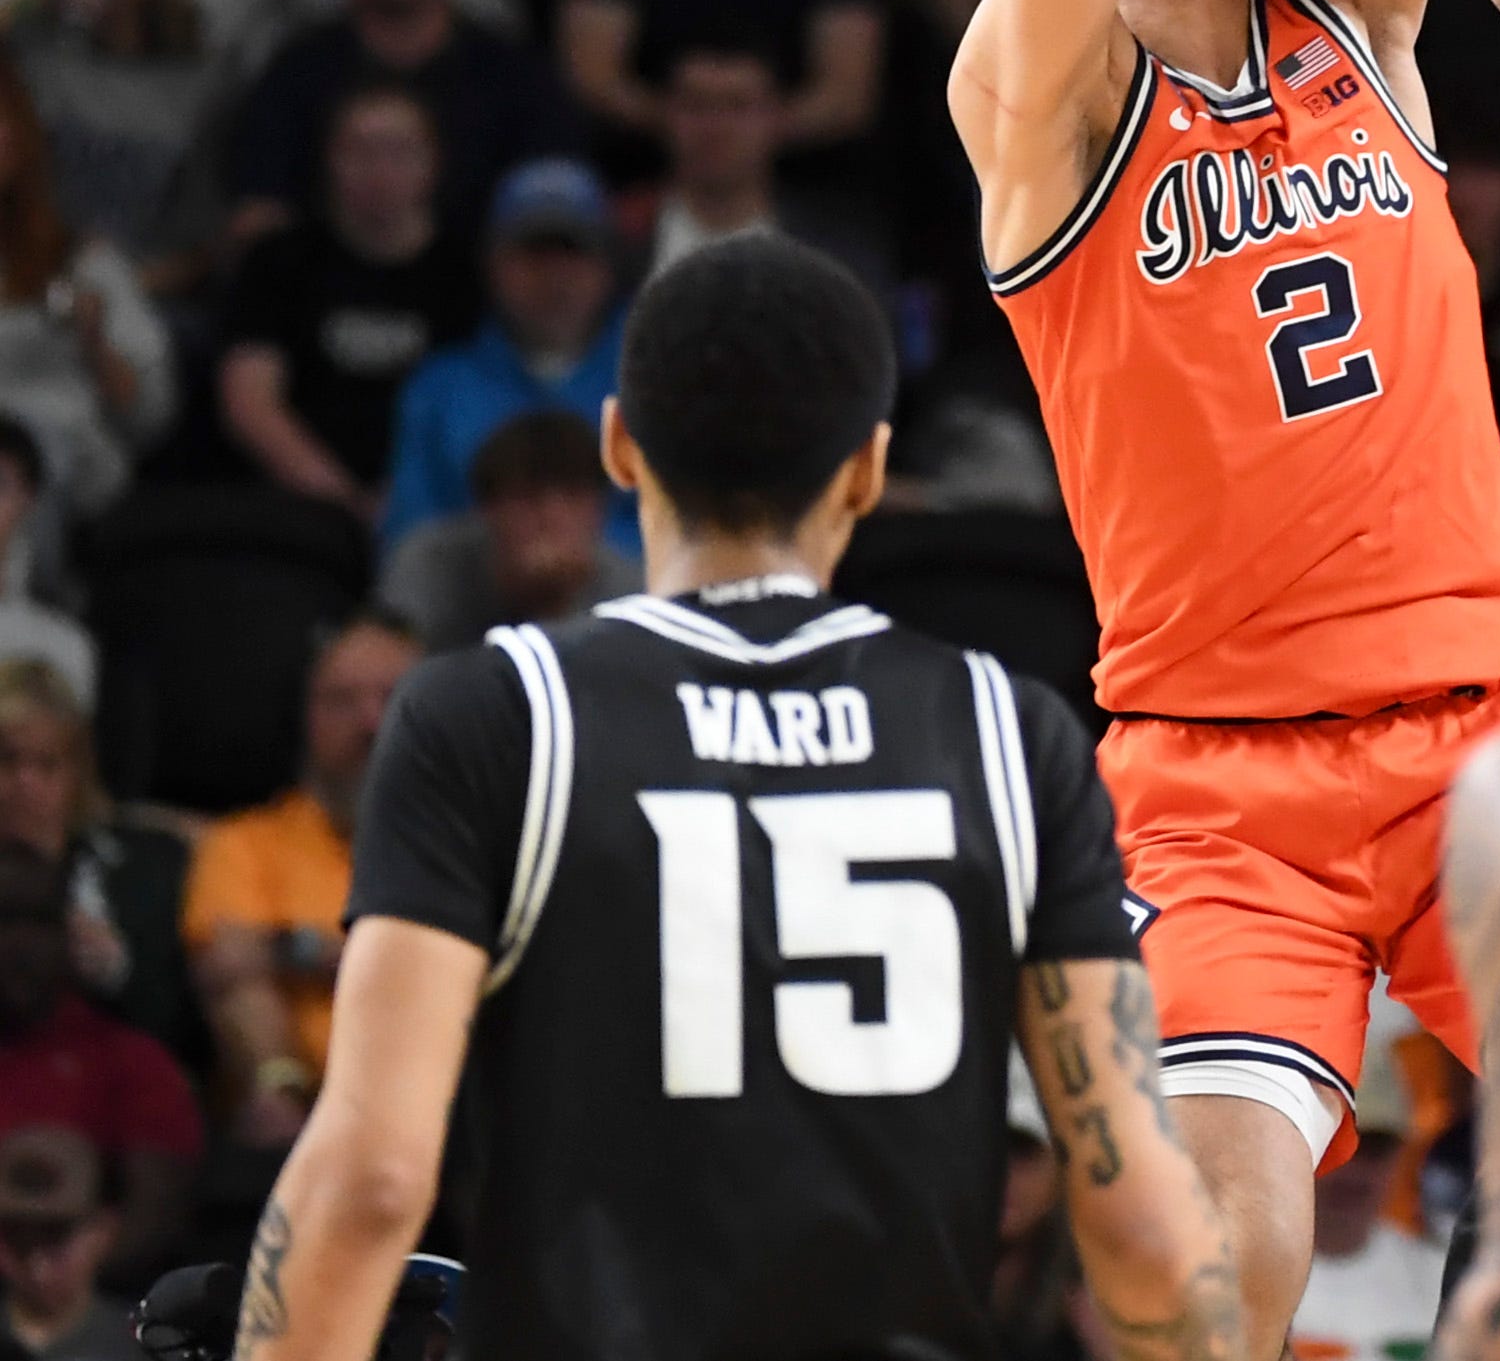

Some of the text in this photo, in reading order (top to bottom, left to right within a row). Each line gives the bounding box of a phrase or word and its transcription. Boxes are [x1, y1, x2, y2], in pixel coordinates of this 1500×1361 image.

[1136, 128, 1414, 285] Illinois
[1251, 251, 1384, 423] 2
[676, 682, 874, 766] WARD
[636, 789, 963, 1098] 15
